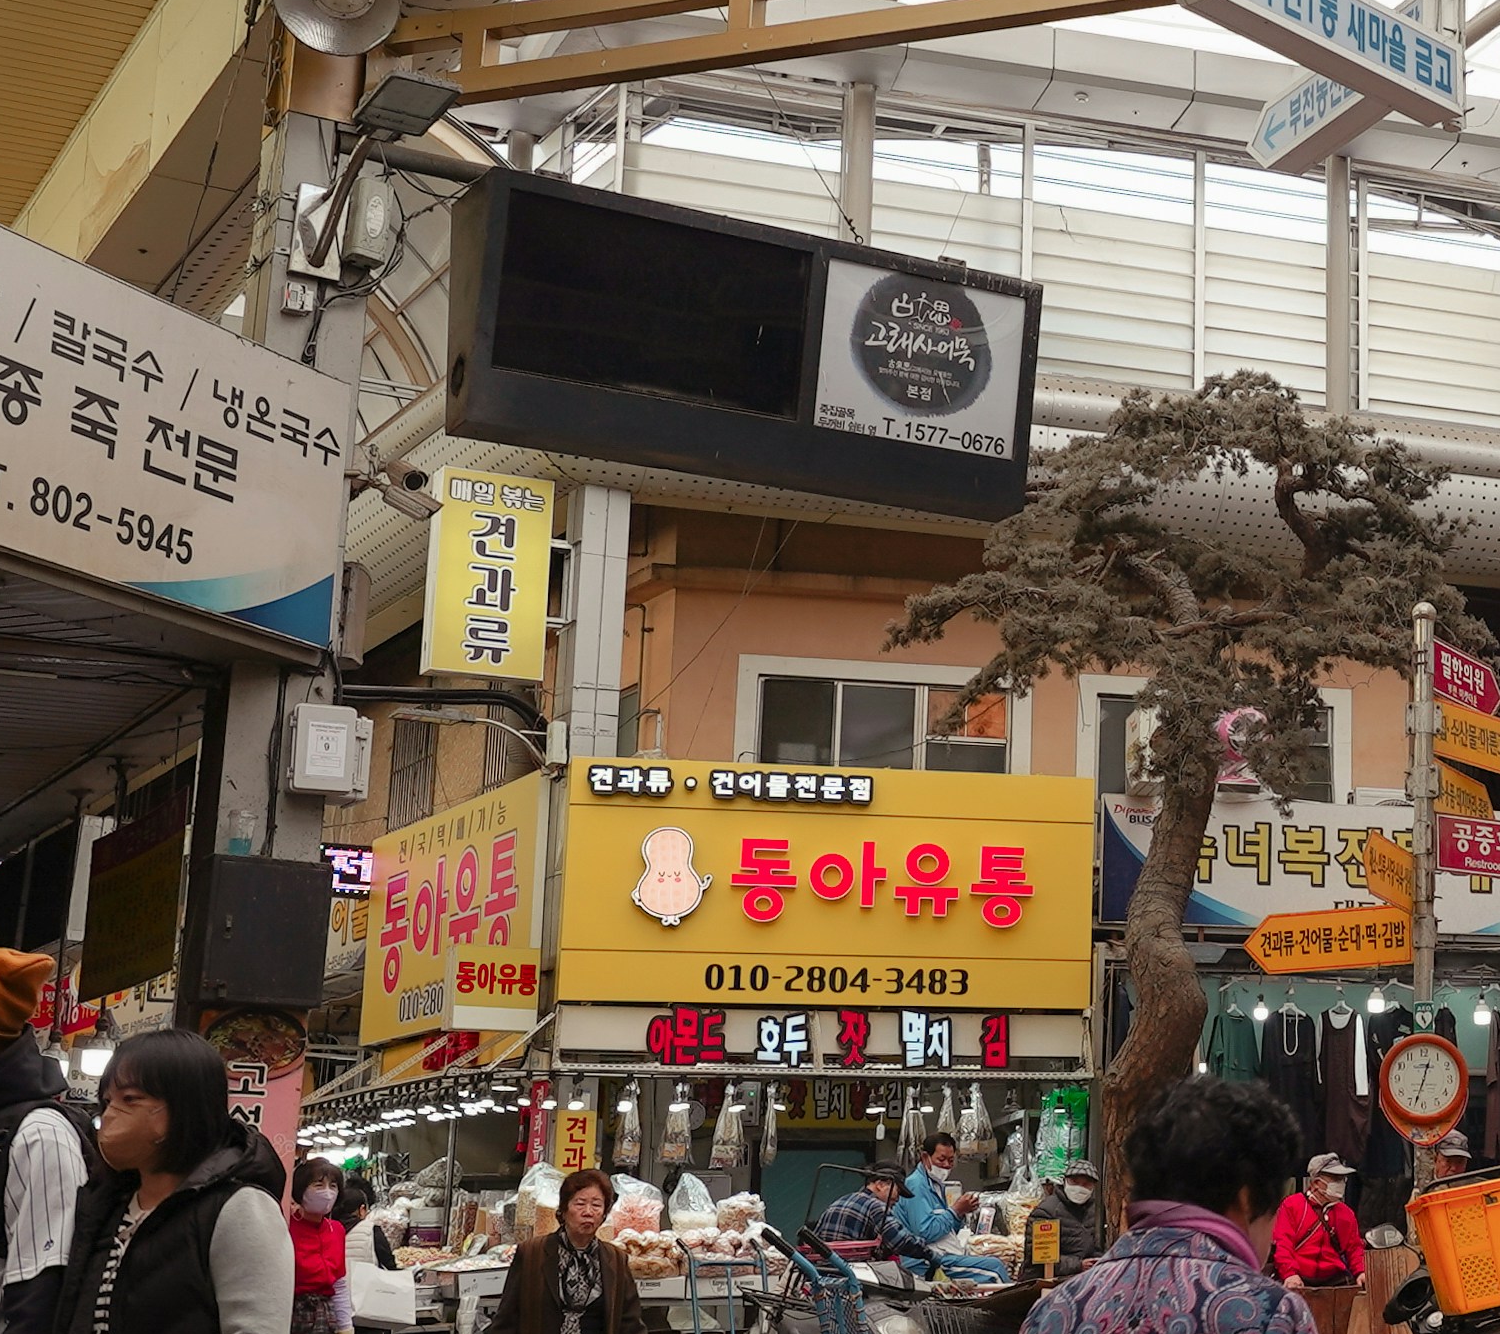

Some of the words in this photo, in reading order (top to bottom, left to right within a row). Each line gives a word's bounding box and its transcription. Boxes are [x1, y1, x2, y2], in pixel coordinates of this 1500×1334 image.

[1347, 1, 1407, 74] 새마을
[1415, 36, 1453, 95] 금고
[865, 321, 975, 371] 고래사어묵
[49, 308, 165, 396] 칼국수
[211, 377, 342, 467] 냉온국수
[906, 384, 932, 401] 본점
[69, 394, 120, 462] 죽
[142, 414, 240, 504] 전문
[29, 474, 196, 568] 802-5945
[448, 477, 496, 506] 매일
[500, 482, 546, 513] 볶는
[461, 510, 519, 667] 견과류
[1440, 651, 1485, 697] 필한의원
[588, 765, 674, 798] 견과류
[709, 770, 874, 806] 건어물전문점
[730, 837, 1036, 930] 동아유통
[456, 961, 538, 996] 동아유통
[704, 963, 970, 996] 010-2804-3483
[647, 1006, 726, 1065] 아몬드
[756, 1012, 810, 1067] 호두
[836, 1009, 871, 1067] 잣
[899, 1009, 952, 1068] 멸치
[979, 1014, 1010, 1069] 김
